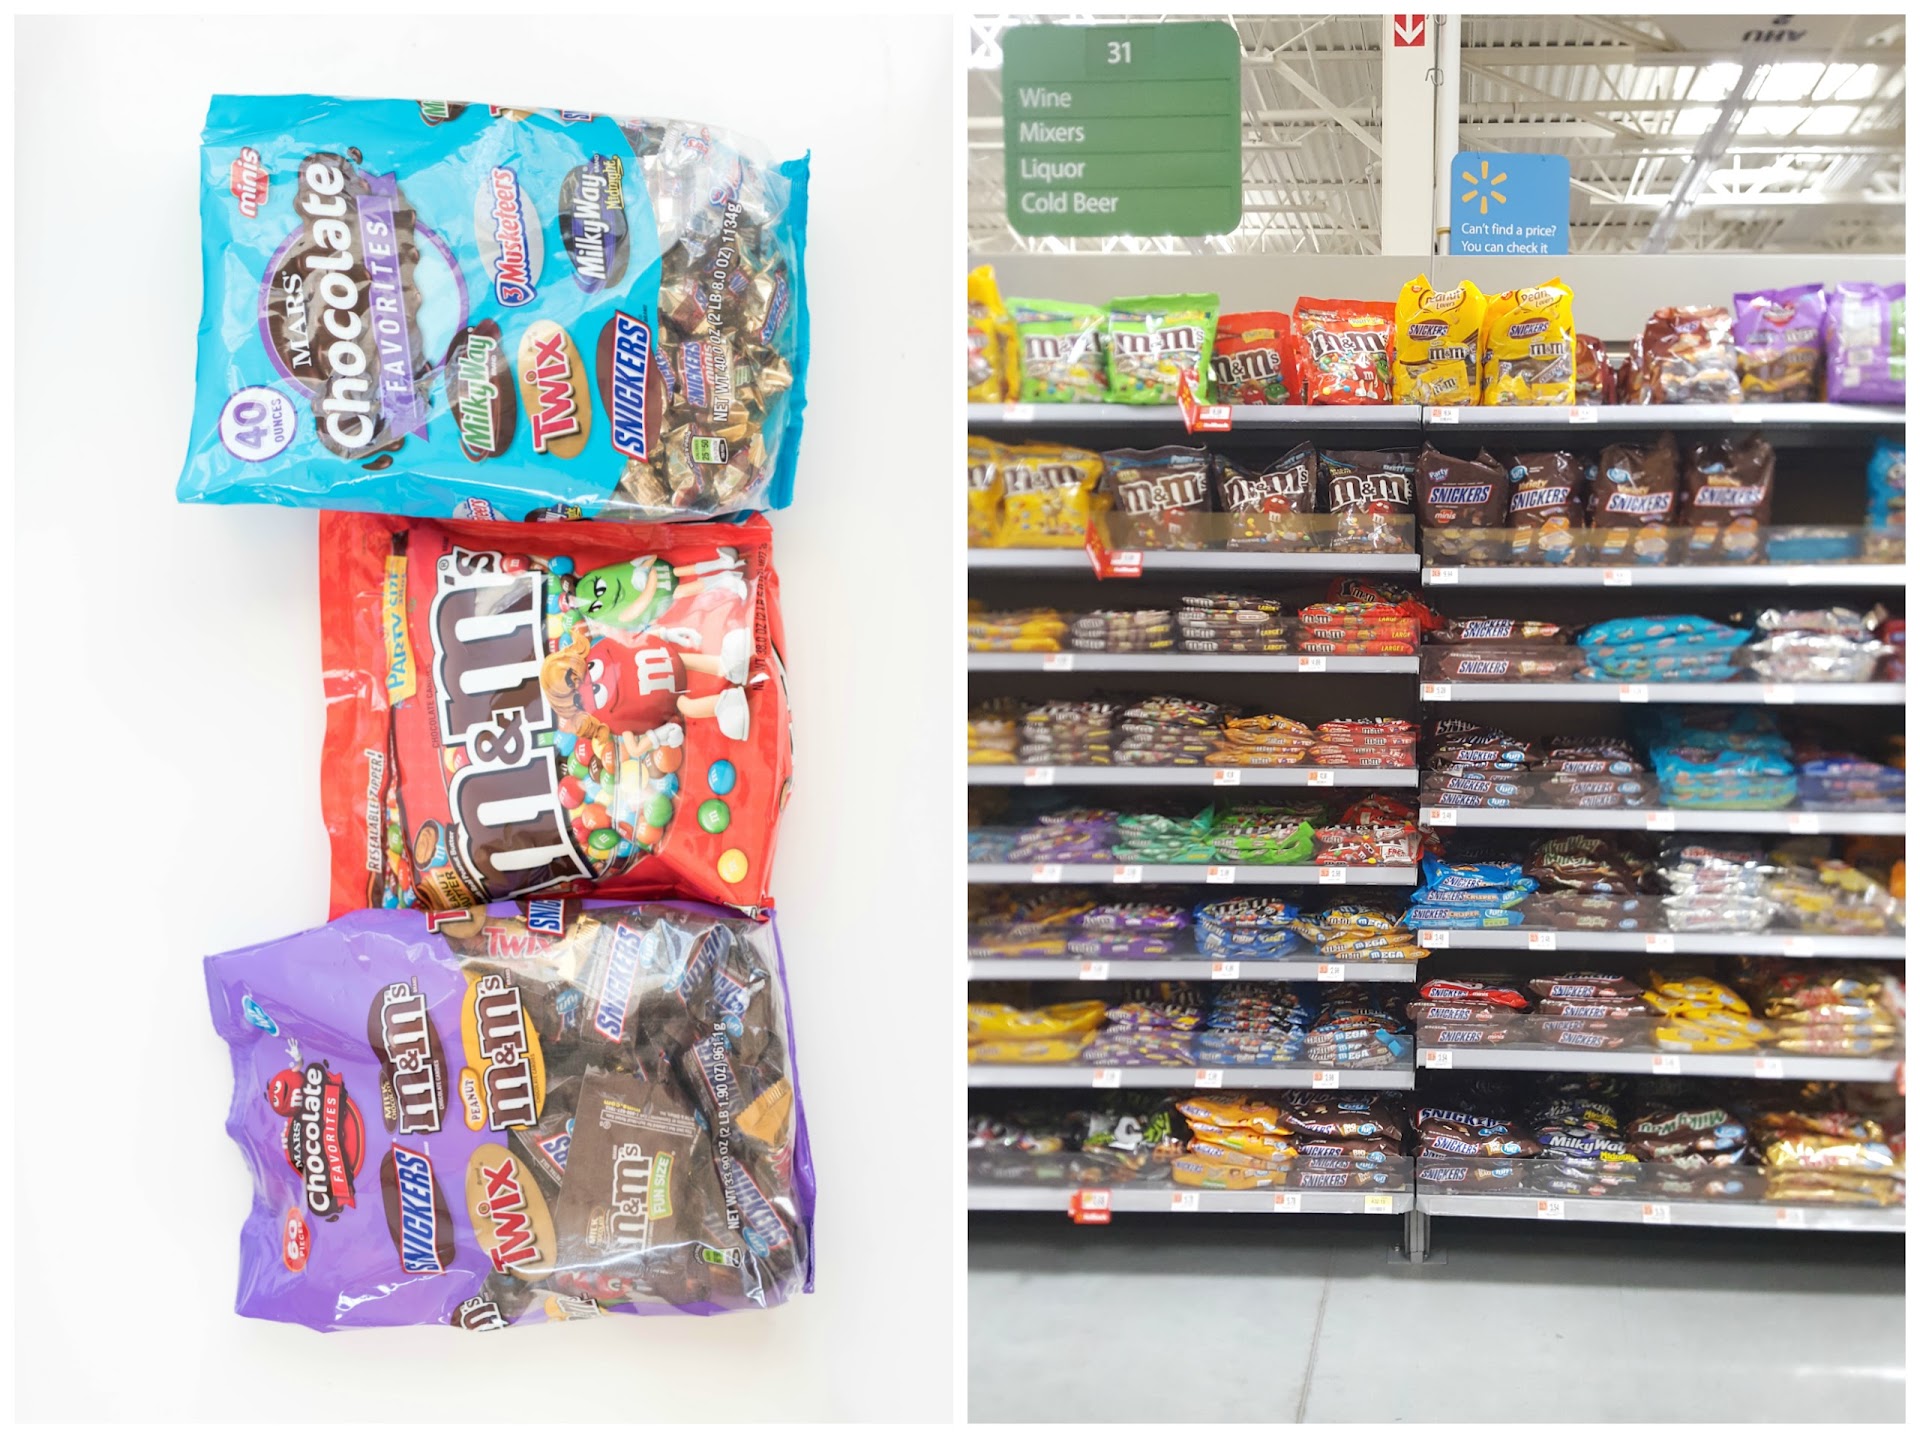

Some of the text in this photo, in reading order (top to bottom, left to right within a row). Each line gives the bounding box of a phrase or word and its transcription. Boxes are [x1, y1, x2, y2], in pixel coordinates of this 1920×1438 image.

[1106, 42, 1132, 64] 31
[1019, 87, 1072, 108] Wine
[1019, 122, 1085, 143] Mixers
[1020, 158, 1086, 182] Liquor
[239, 147, 259, 218] minis
[606, 155, 625, 211] Midnight
[1021, 191, 1119, 214] Cold Beer
[491, 168, 524, 284] Musketeers
[1461, 222, 1557, 239] Can't find a price?
[1461, 240, 1549, 254] You can check it
[306, 162, 374, 447] Chocolate
[367, 219, 408, 392] FAVORITES
[707, 202, 742, 422] NET WT 40.0 OZ (2 LB 8.0 OZ) 1134g
[283, 273, 311, 369] MARS
[1408, 324, 1450, 337] SNICKERS
[1509, 321, 1550, 337] SNICKERS
[613, 315, 651, 458] SNICKERS
[233, 402, 268, 448] 40
[273, 398, 284, 443] OUNCES
[1429, 468, 1449, 479] Party
[1429, 486, 1491, 504] SNICKERS
[1511, 488, 1571, 512] SNICKERS
[1607, 492, 1673, 514] SNICKERS
[1434, 512, 1457, 520] minis
[387, 613, 408, 690] PARTY
[1458, 660, 1509, 674] SNICKERS
[1448, 777, 1491, 792] SNICKERS
[368, 802, 381, 870] RESEALABLE
[437, 871, 460, 908] EANUT
[1412, 908, 1449, 919] SNICKERS
[596, 924, 642, 1038] SNICKERS
[1550, 985, 1596, 997] SNICKERS
[1427, 1007, 1472, 1020] SNICKERS
[1562, 1005, 1607, 1018] SNICKERS
[1438, 1031, 1483, 1043] SNICKERS
[381, 1081, 392, 1119] MILK
[466, 1079, 480, 1122] PEANUT
[712, 1022, 740, 1230] NET WT 33.90 OZ (2 LB 1.90 OZ) 961.1g
[292, 1121, 304, 1168] MARS
[307, 1067, 329, 1213] Chocolate
[325, 1096, 344, 1184] FAVORITES
[1433, 1136, 1479, 1154] SNICKERS
[653, 1157, 670, 1215] FUN SIZE
[1301, 1173, 1348, 1186] SNICKERS
[1420, 1167, 1468, 1181] SNICKERS
[395, 1148, 440, 1273] SNICKERS
[287, 1219, 300, 1260] 60
